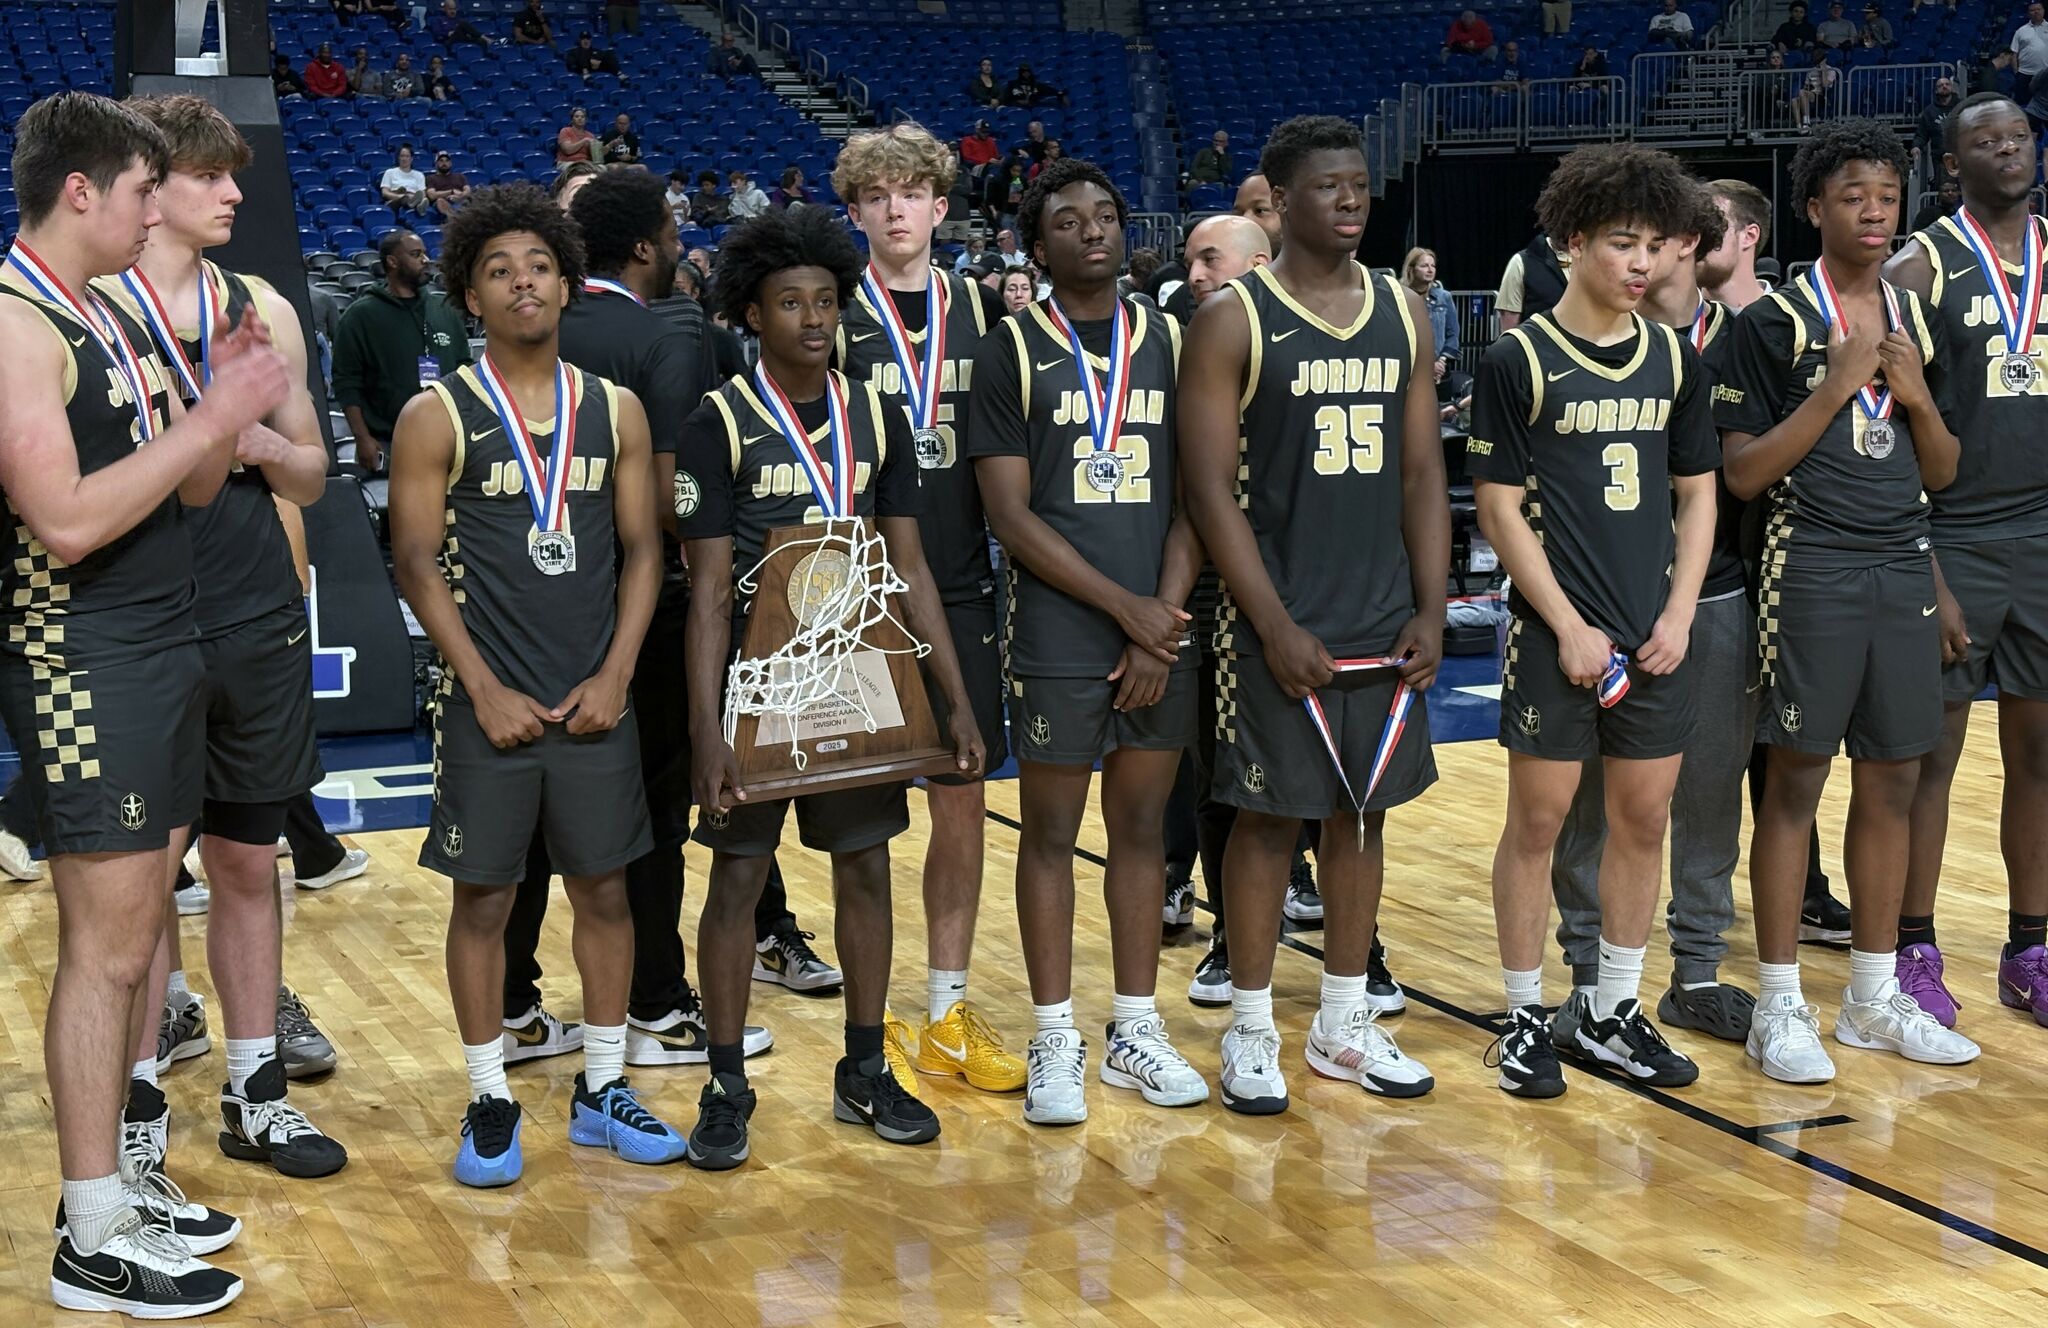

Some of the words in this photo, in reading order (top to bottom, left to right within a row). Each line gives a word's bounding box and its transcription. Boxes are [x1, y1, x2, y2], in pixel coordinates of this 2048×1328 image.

[1291, 358, 1400, 396] JORDAN
[1555, 398, 1671, 434] JORDAN
[1313, 404, 1383, 475] 35
[1602, 442, 1640, 511] 3
[813, 719, 842, 729] DIVISION
[823, 742, 841, 751] 2025
